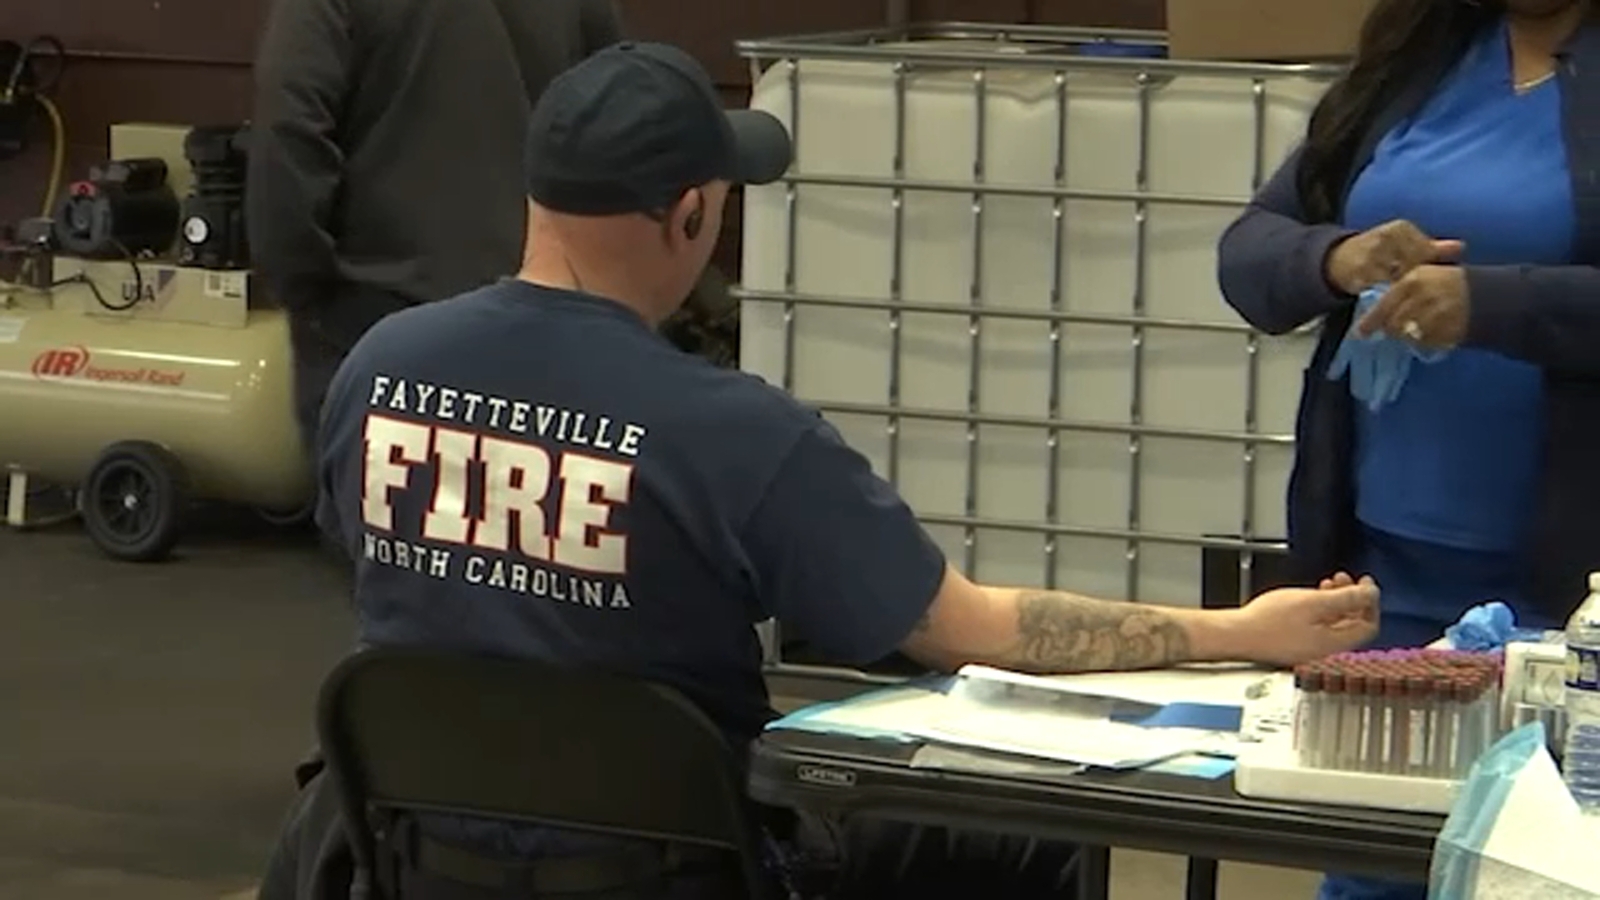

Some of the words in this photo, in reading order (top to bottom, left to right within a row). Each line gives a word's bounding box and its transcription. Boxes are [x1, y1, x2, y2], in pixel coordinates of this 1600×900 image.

[370, 376, 645, 456] FAYETTEVILLE
[361, 413, 635, 577] FIRE
[363, 532, 451, 578] NORTH
[464, 556, 631, 609] CAROLINA
